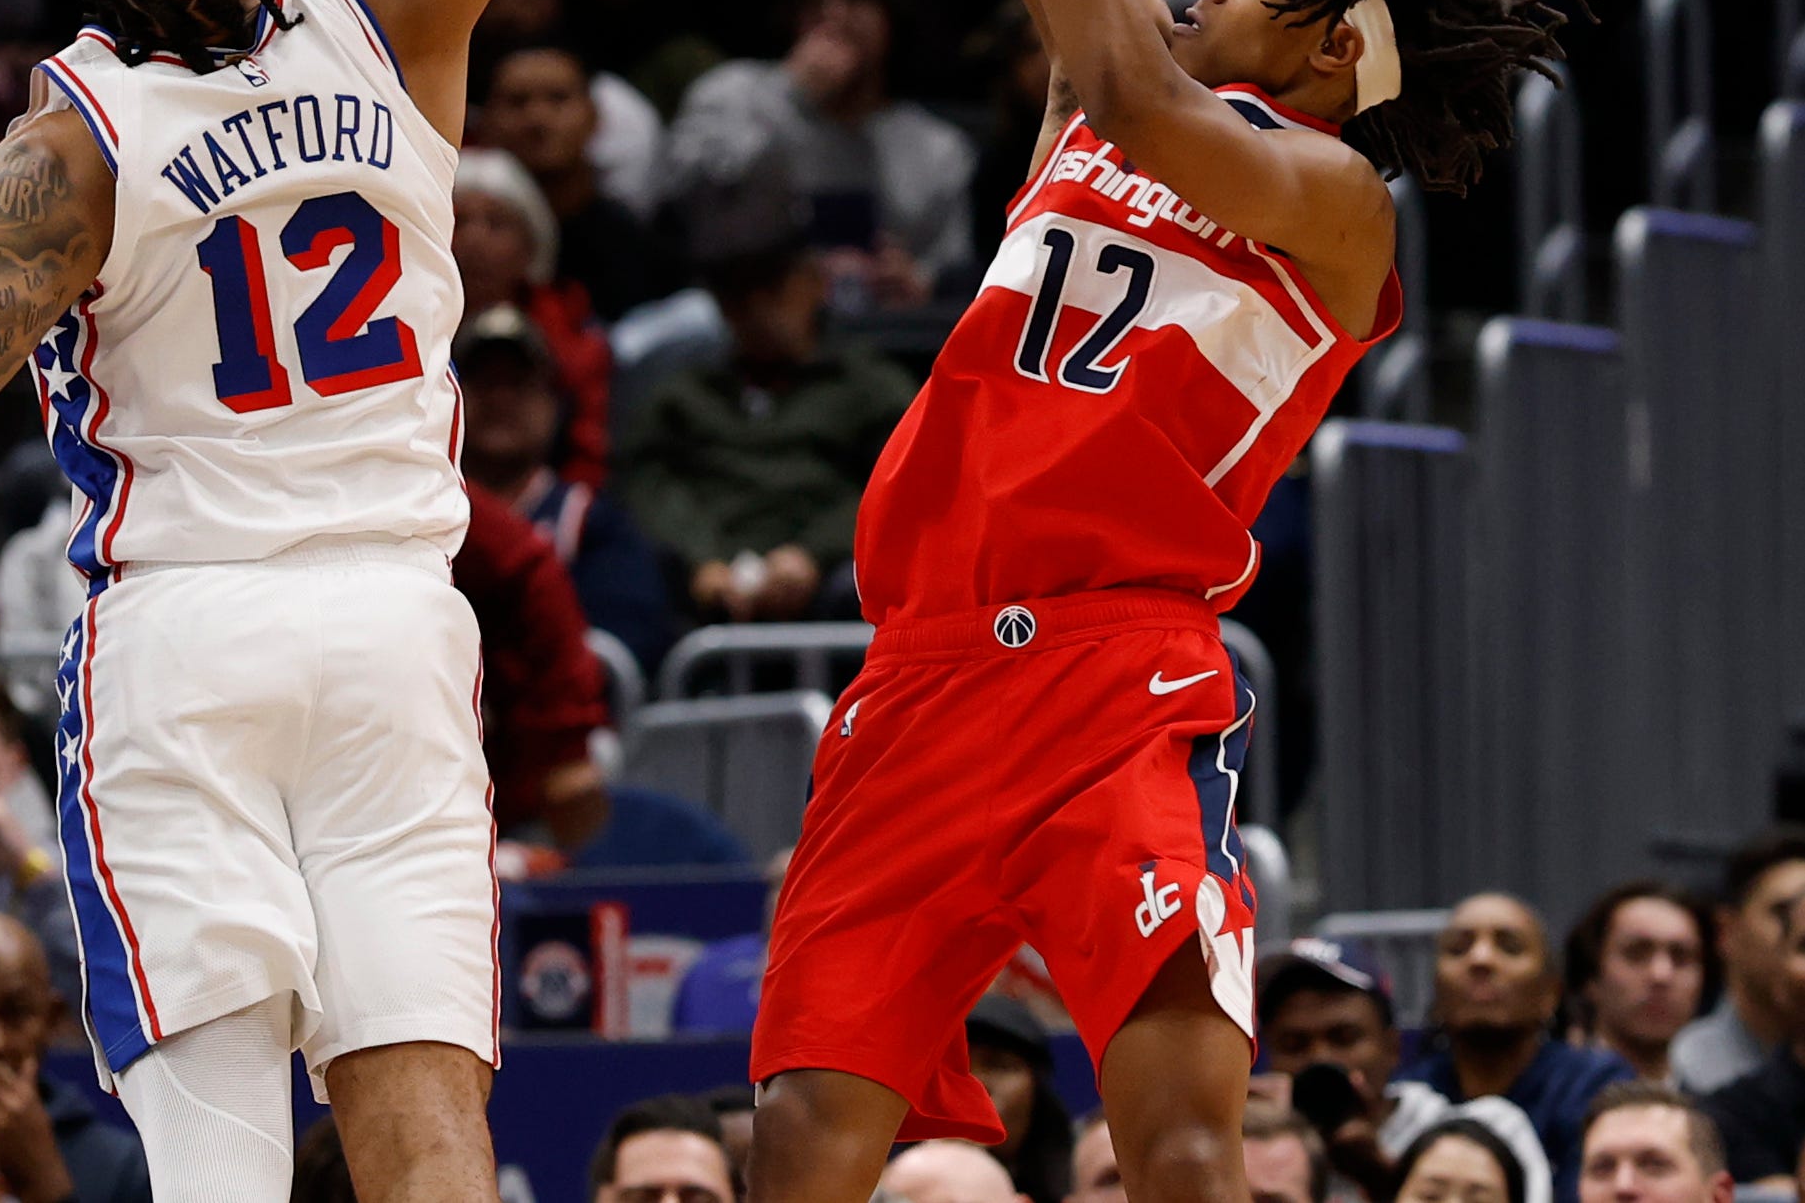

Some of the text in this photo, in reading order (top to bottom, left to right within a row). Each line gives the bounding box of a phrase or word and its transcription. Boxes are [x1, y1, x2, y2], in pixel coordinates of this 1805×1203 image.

[161, 93, 394, 215] WATFORD
[196, 190, 424, 415] 12
[1013, 226, 1159, 395] 12
